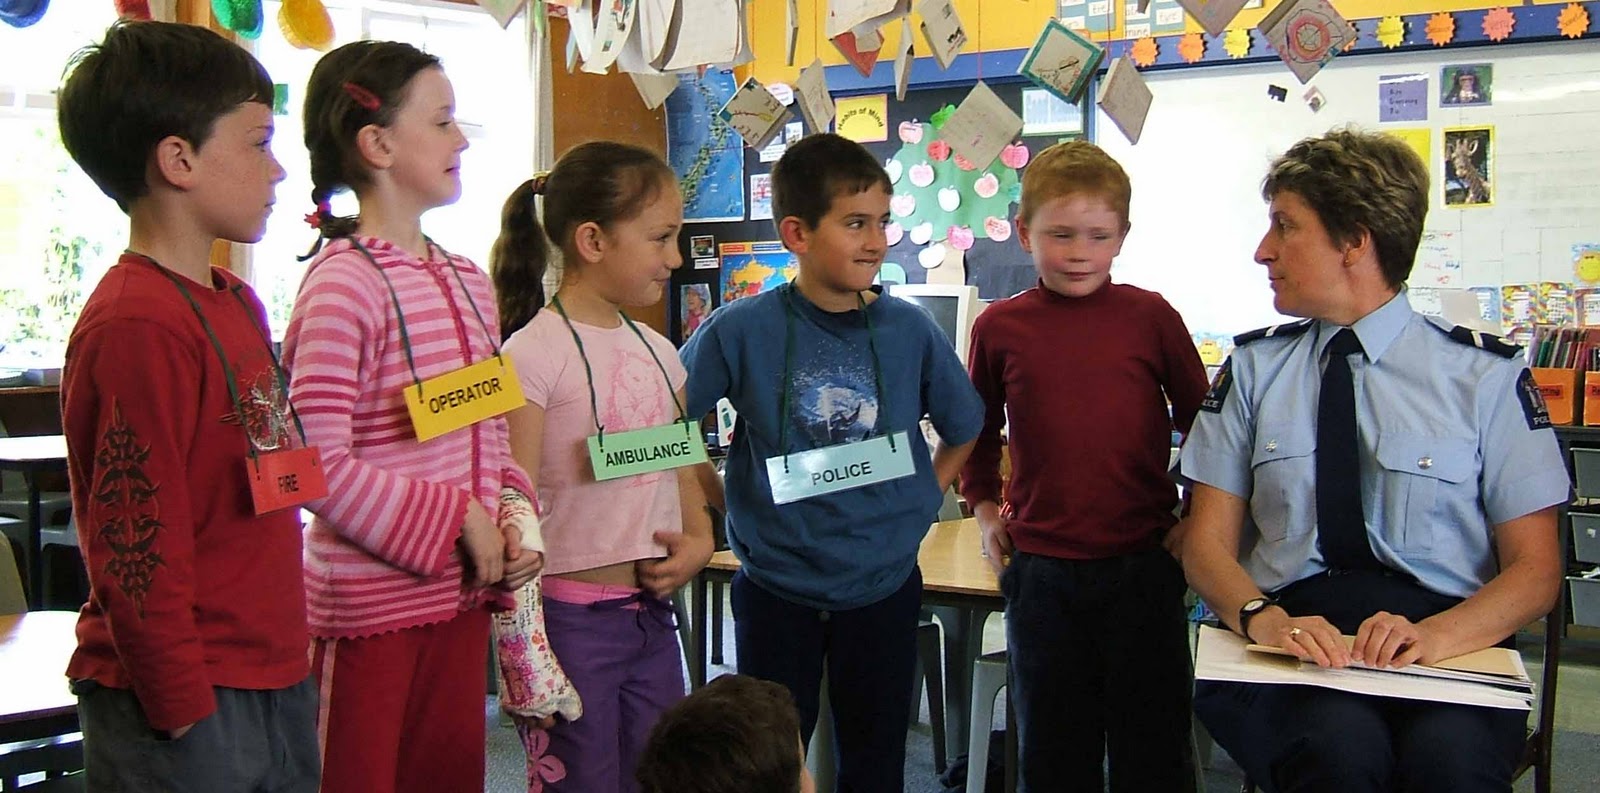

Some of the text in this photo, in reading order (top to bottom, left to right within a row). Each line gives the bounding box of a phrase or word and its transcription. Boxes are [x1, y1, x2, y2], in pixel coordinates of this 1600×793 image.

[838, 107, 884, 130] Habits of Mind
[429, 377, 503, 414] OPERATOR
[606, 441, 691, 468] AMBULANCE
[278, 474, 299, 493] FIRE
[811, 461, 872, 486] POLICE
